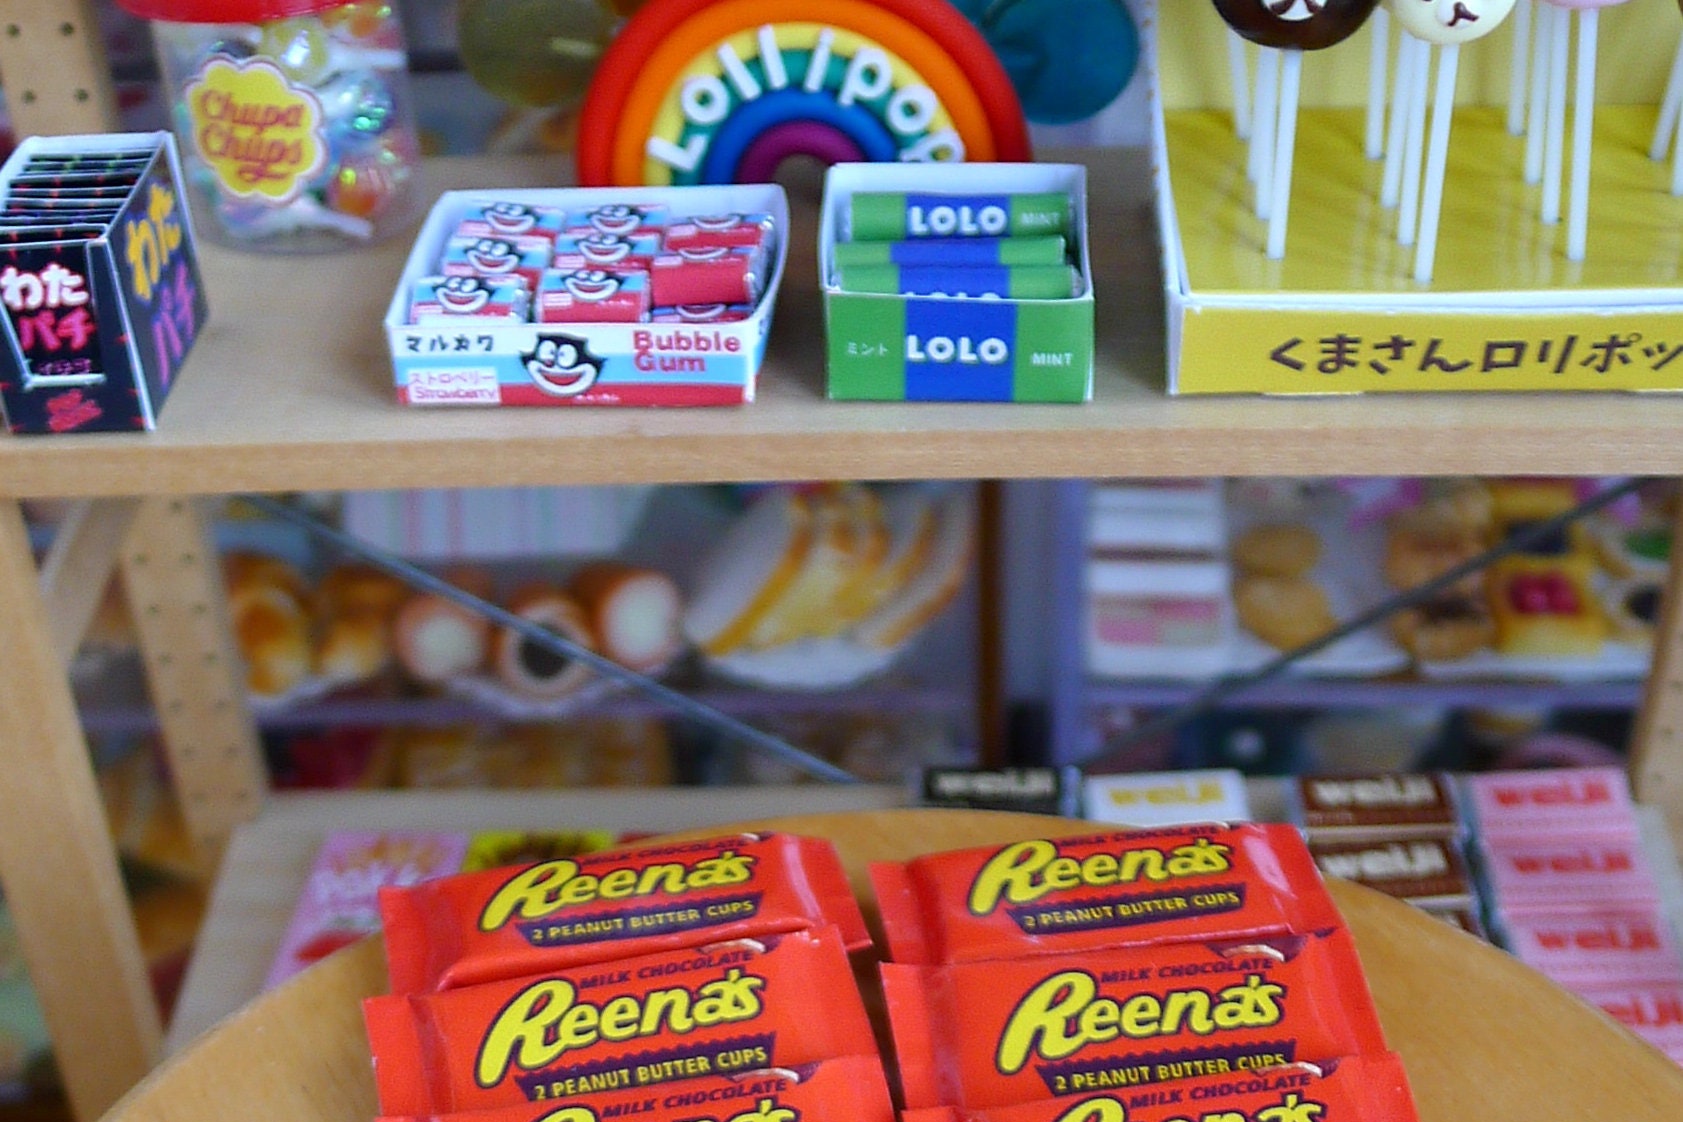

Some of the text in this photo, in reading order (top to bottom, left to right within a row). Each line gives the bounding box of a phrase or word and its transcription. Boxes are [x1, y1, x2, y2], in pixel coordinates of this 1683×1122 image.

[201, 89, 304, 134] Chupa
[202, 122, 303, 184] Chups
[909, 206, 1061, 236] LOLO MINT
[0, 264, 88, 310] わた
[18, 307, 96, 351] パチ
[633, 331, 741, 353] Bubble
[635, 350, 707, 372] Gum
[847, 342, 889, 357] ミント
[906, 335, 1074, 367] LOLO MINT
[479, 850, 756, 932] Reena's
[967, 838, 1231, 915] Reena's
[532, 900, 754, 940] 2 PEANUT BUTTER CUPS
[1024, 891, 1240, 928] 2 PEANUT BUTTER CUPS
[580, 951, 753, 989] MILK CHOCOLATE
[1101, 957, 1273, 984] MILK CHOCOLATE
[476, 968, 766, 1087] Reena's
[997, 972, 1285, 1074] Reena's
[535, 1047, 767, 1100] 2 PEANUT BUTTER CUPS
[1054, 1052, 1287, 1091] 2 PEANUT BUTTER CUPS
[1130, 1075, 1312, 1107] MILK CHOCOLATE
[602, 1078, 787, 1118] MILK CHOCOLATE
